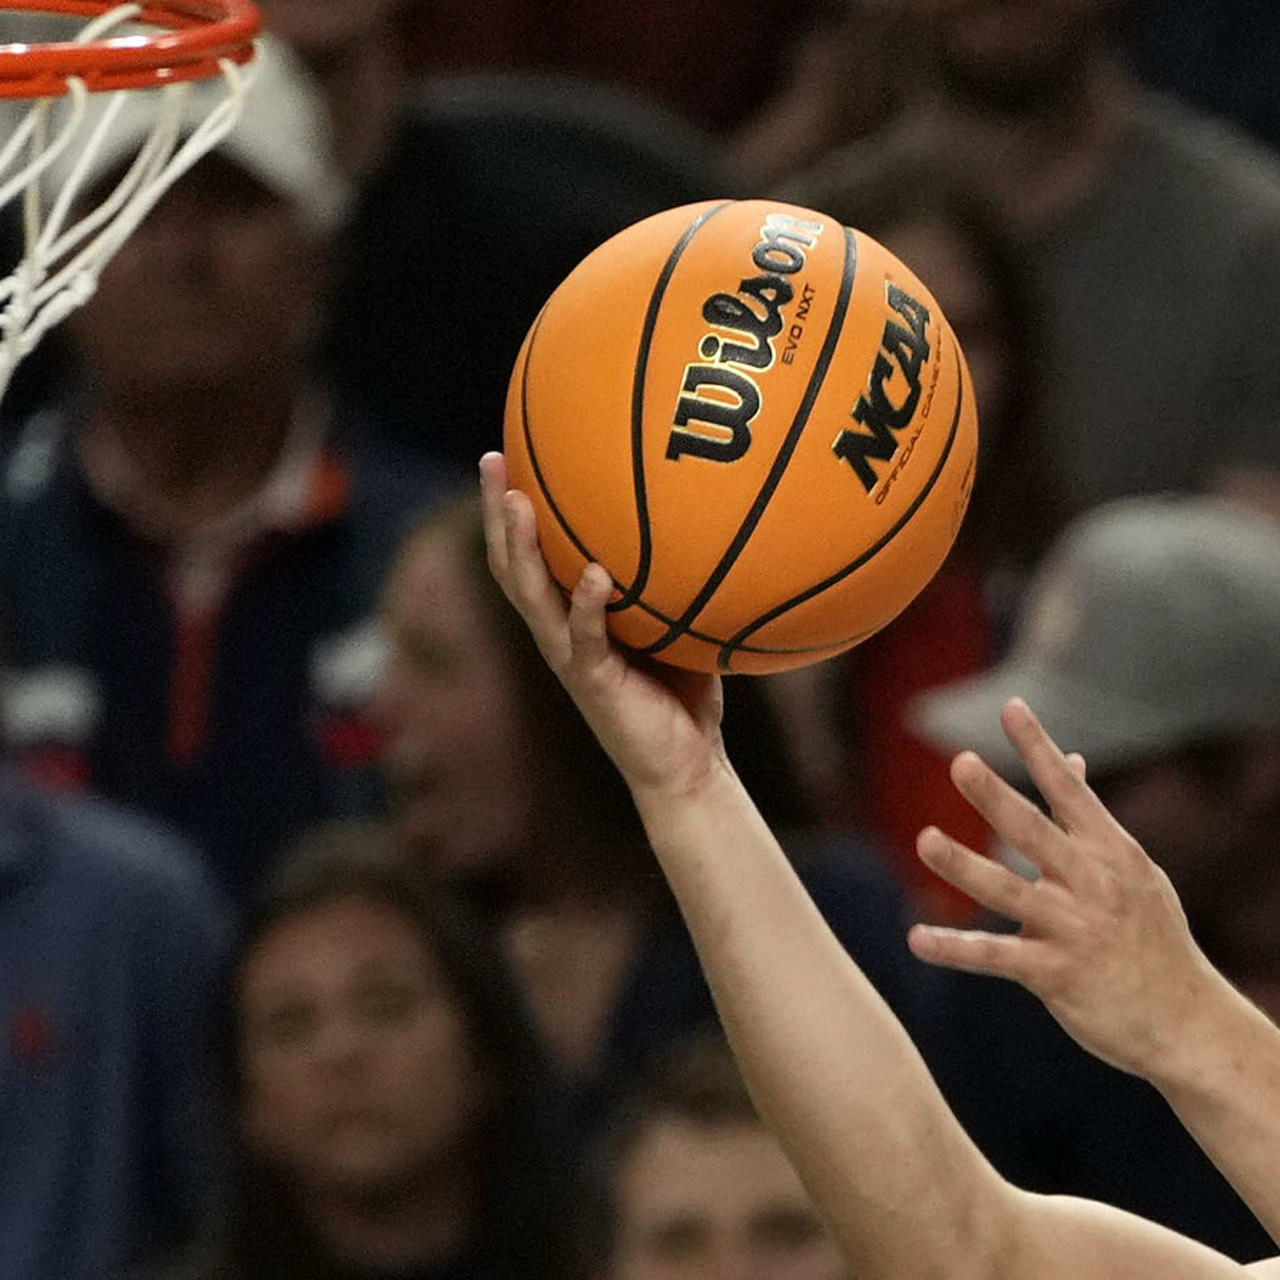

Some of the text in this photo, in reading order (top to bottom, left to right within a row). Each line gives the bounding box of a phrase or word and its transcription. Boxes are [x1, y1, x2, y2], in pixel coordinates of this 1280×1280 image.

[665, 212, 824, 464] Wilson
[781, 282, 817, 366] EVO NXT
[831, 279, 931, 498] NCAA
